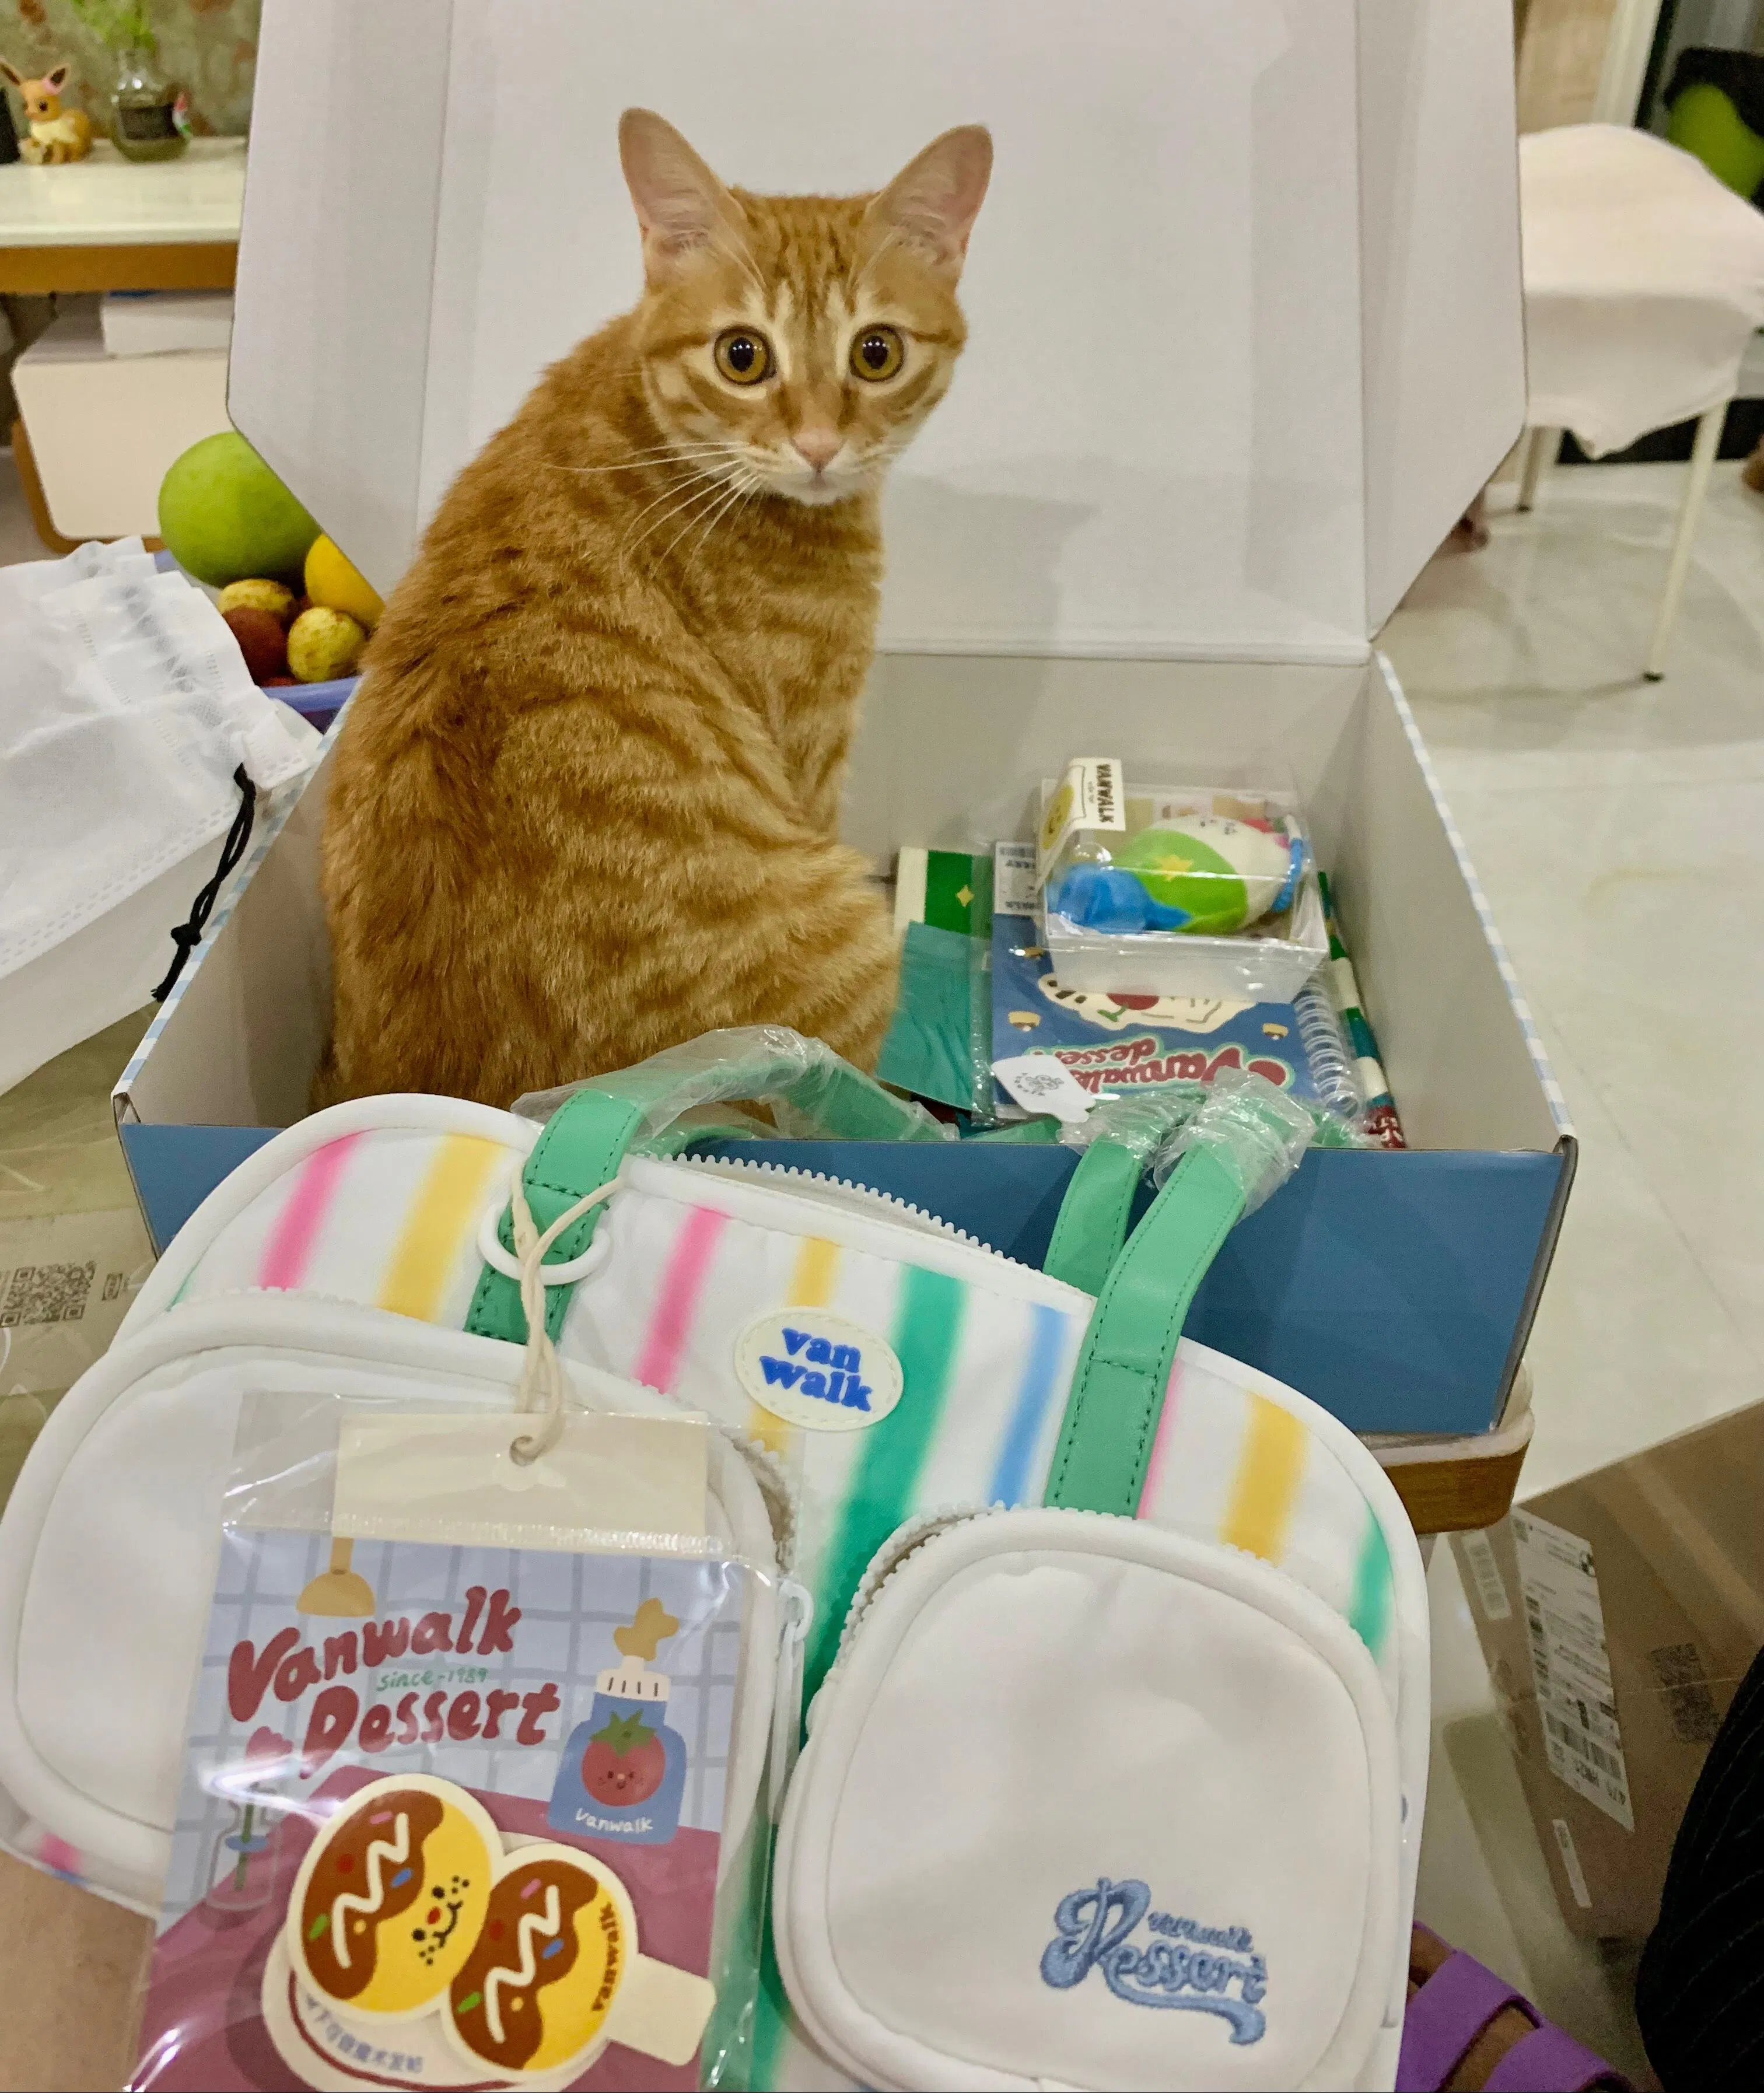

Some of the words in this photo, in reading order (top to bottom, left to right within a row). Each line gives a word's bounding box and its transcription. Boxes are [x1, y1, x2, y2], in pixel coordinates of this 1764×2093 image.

[760, 1355, 873, 1412] walk
[782, 1327, 861, 1373] van
[228, 1585, 522, 1721] Vanwalk
[299, 1682, 560, 1779] Dessert
